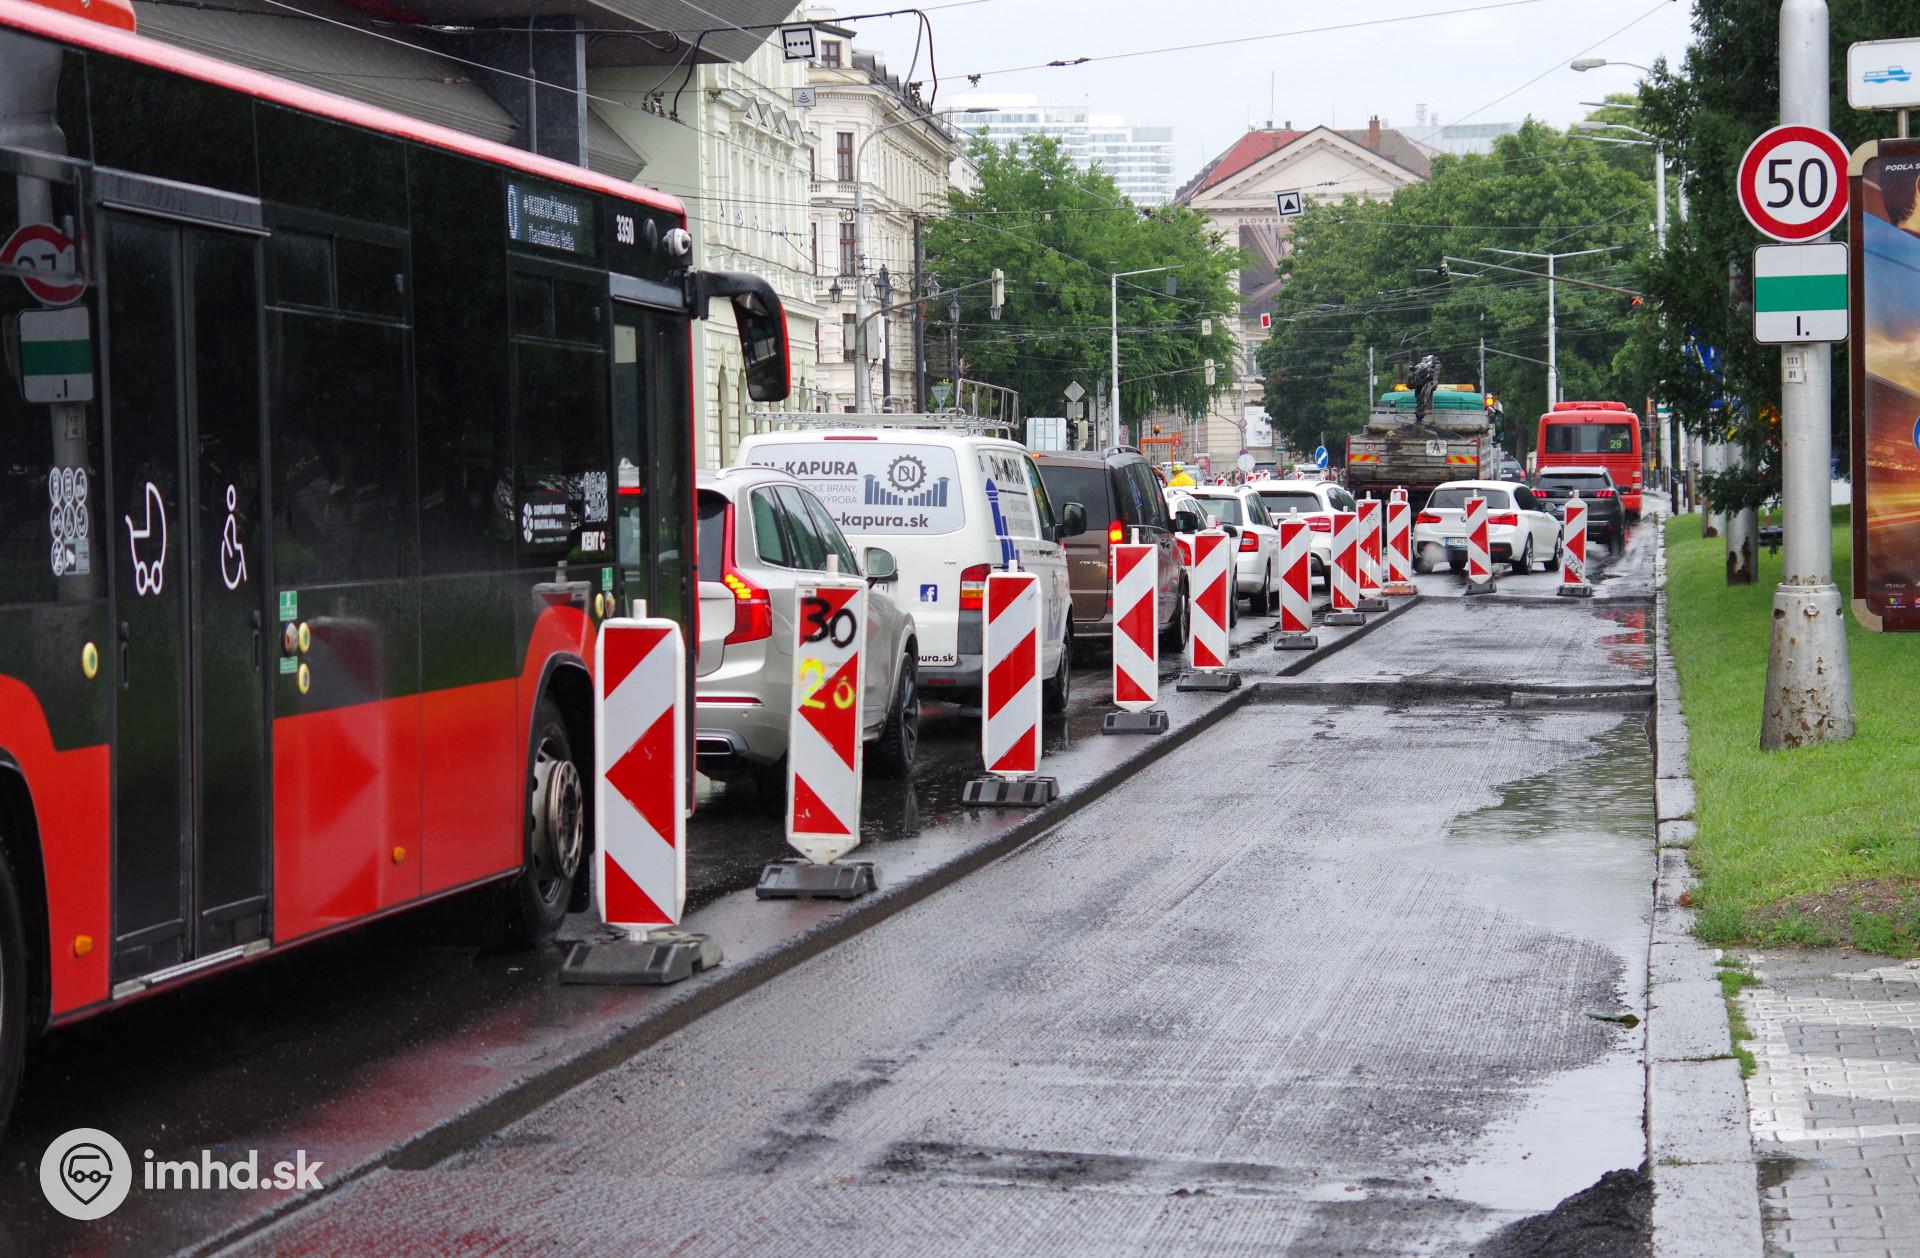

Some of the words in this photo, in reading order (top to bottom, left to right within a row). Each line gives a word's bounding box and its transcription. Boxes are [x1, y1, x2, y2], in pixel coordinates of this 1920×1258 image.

[1767, 158, 1828, 208] 50
[616, 214, 635, 245] 3350
[1610, 439, 1622, 449] 29
[582, 530, 599, 552] KENT
[599, 530, 606, 552] C
[800, 596, 857, 649] 30
